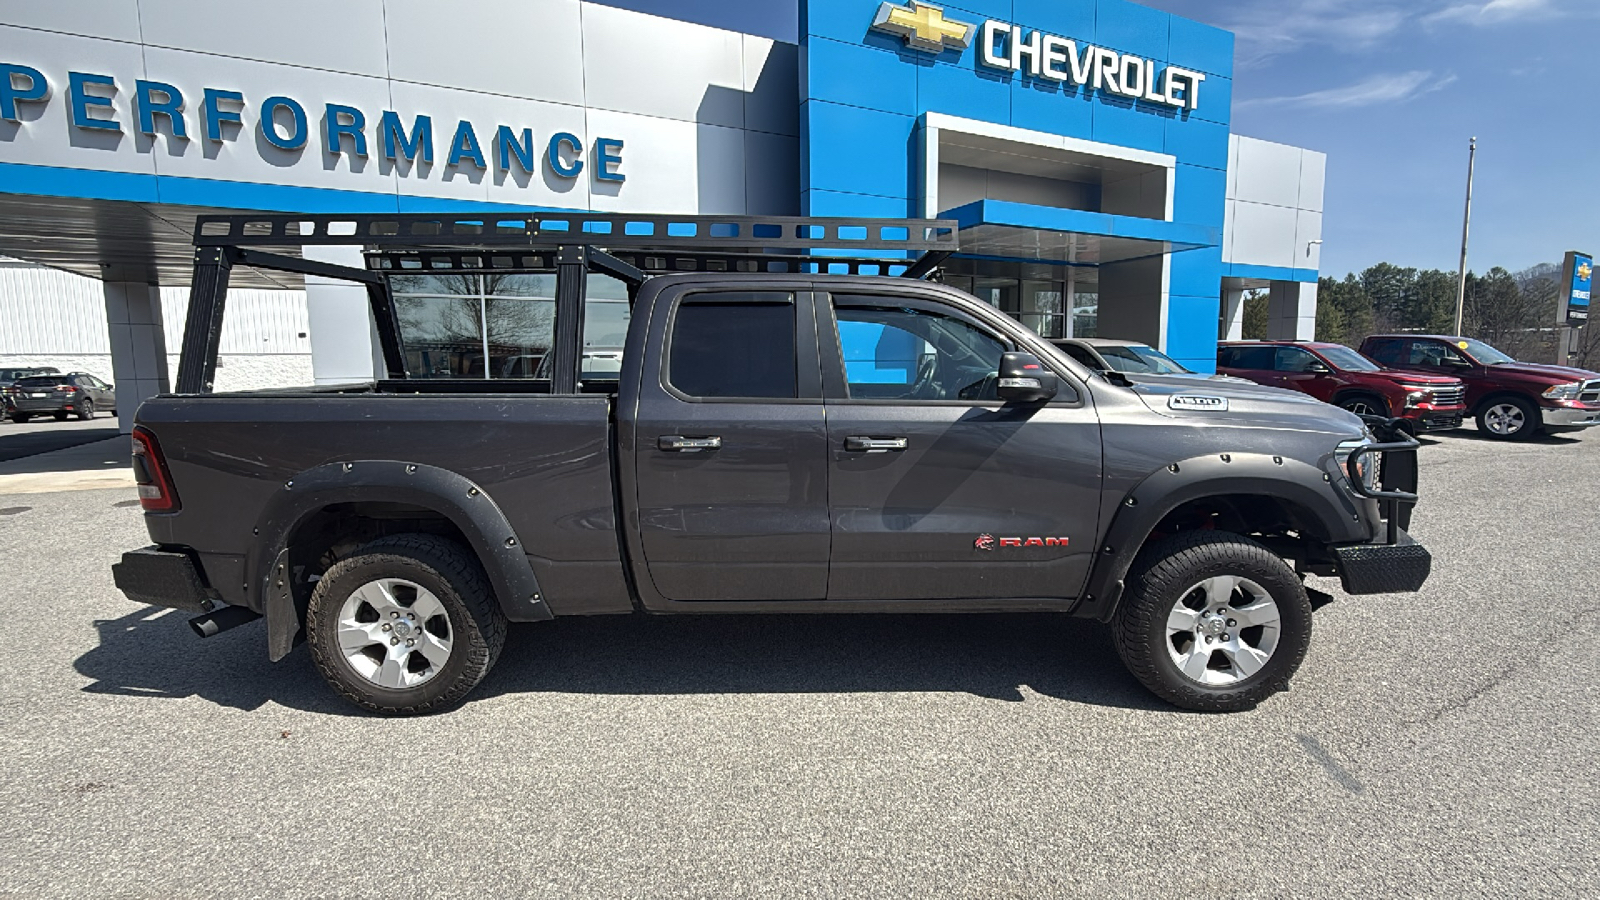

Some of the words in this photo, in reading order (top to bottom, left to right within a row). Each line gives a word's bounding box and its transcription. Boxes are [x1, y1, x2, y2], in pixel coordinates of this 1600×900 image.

[983, 19, 1205, 110] CHEVROLET
[0, 62, 626, 182] PERFORMANCE
[999, 537, 1069, 547] RAM
